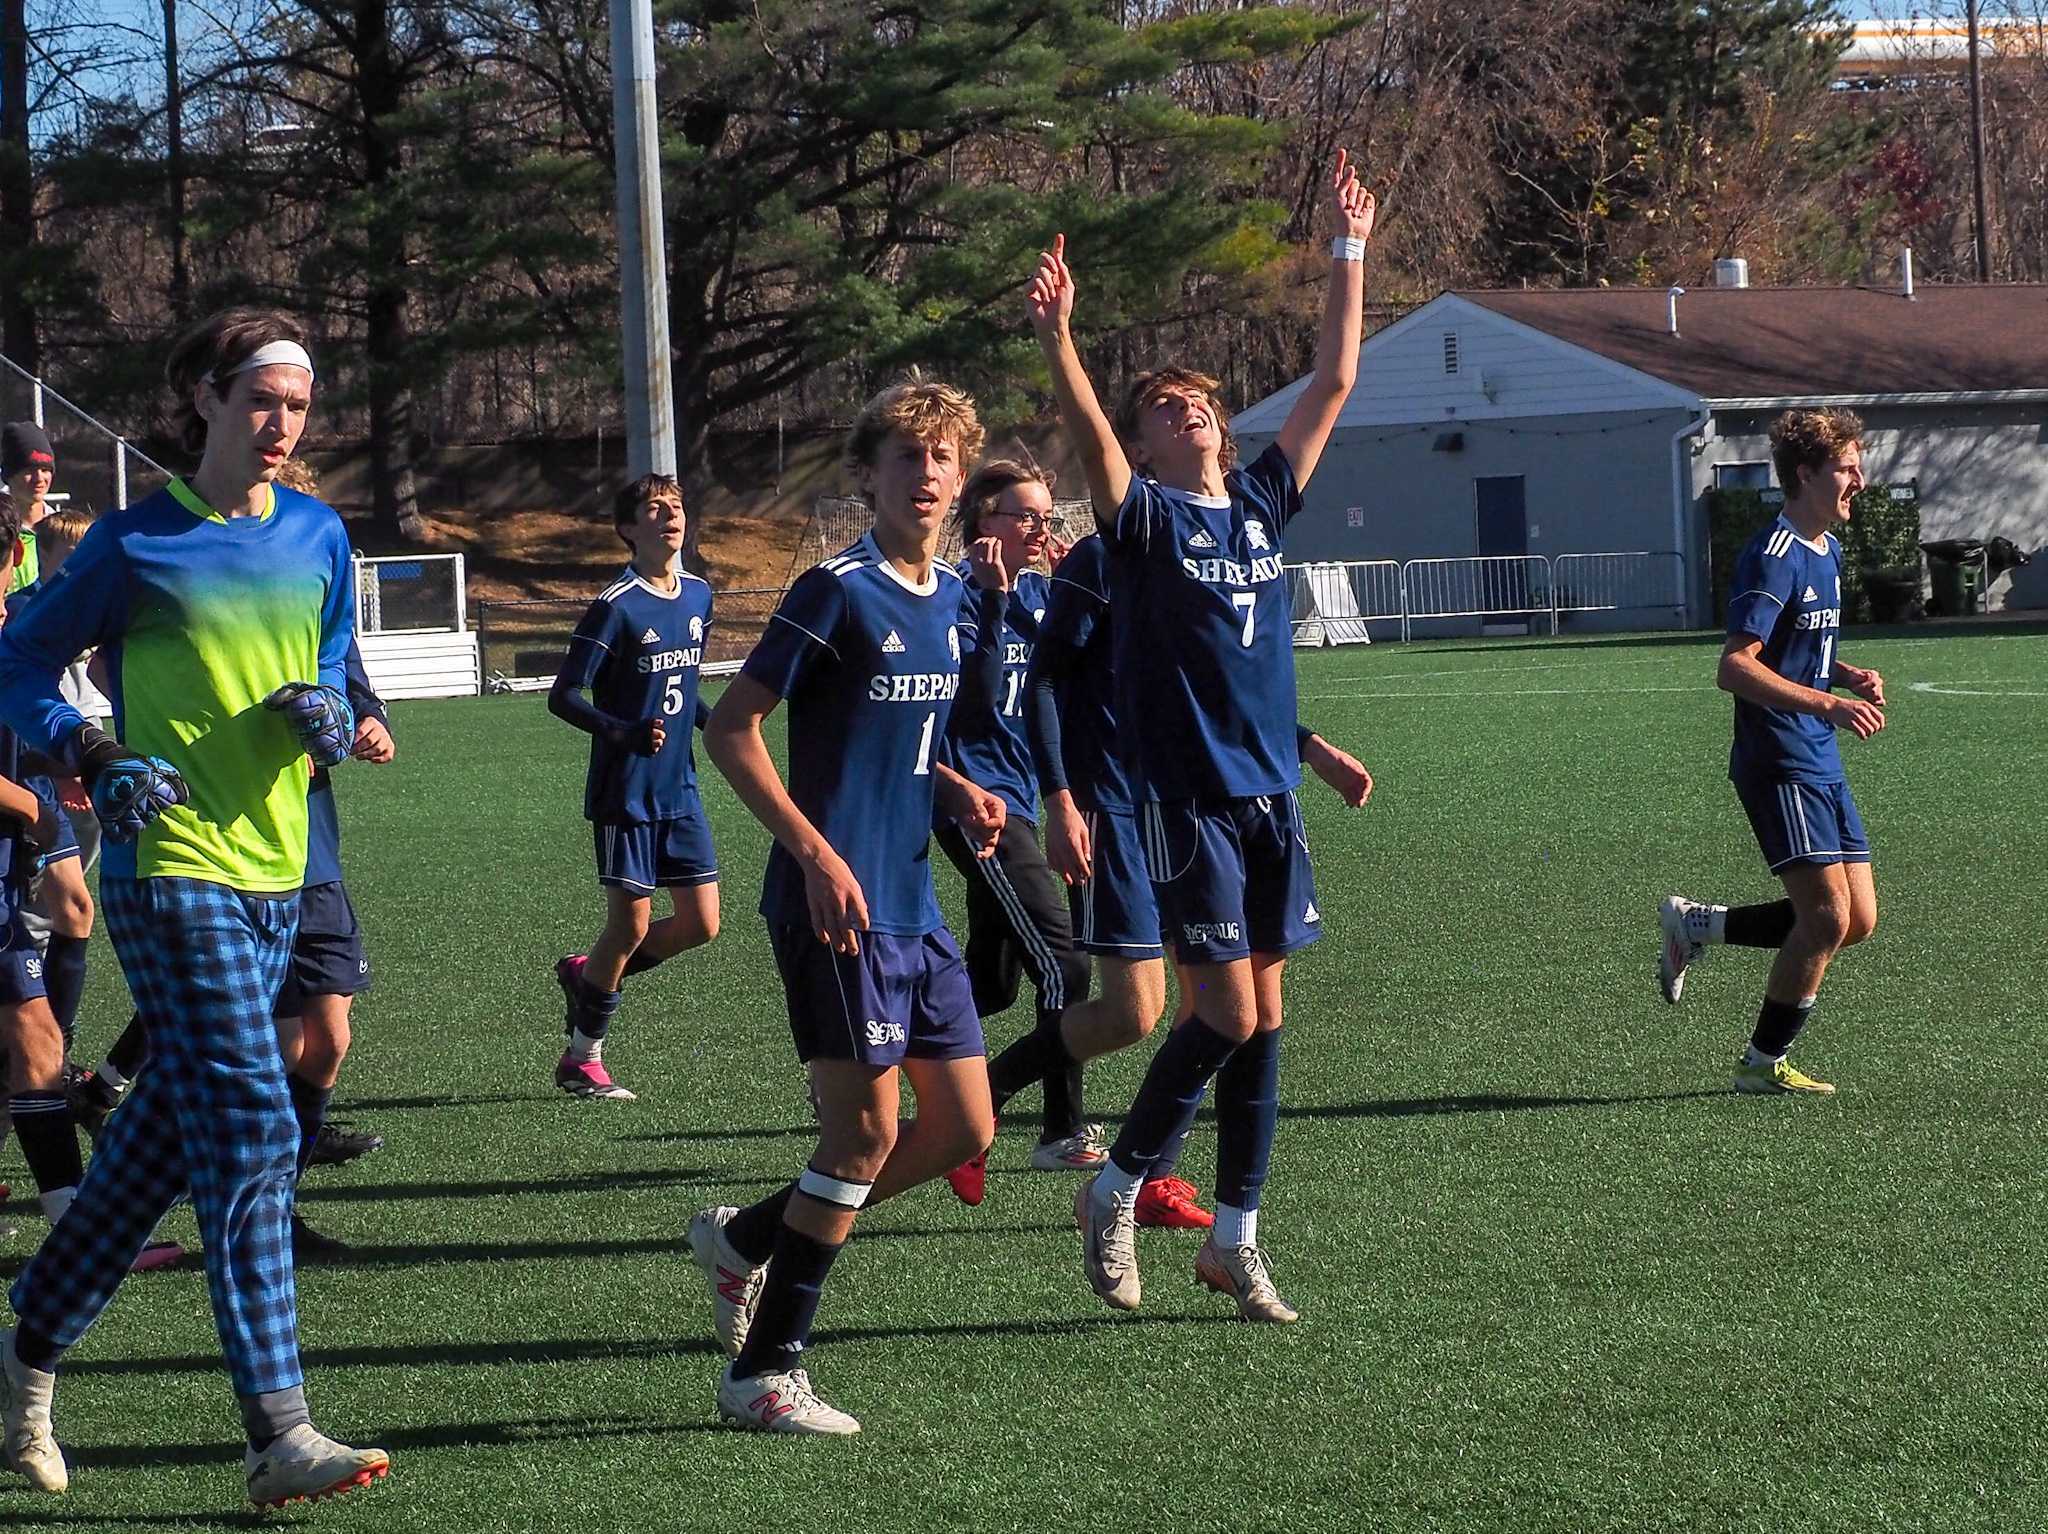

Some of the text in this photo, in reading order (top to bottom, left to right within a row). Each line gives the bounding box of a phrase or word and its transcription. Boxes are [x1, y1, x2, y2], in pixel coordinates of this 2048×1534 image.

[1231, 592, 1257, 648] 7
[663, 674, 684, 716] 5
[913, 711, 936, 775] 1
